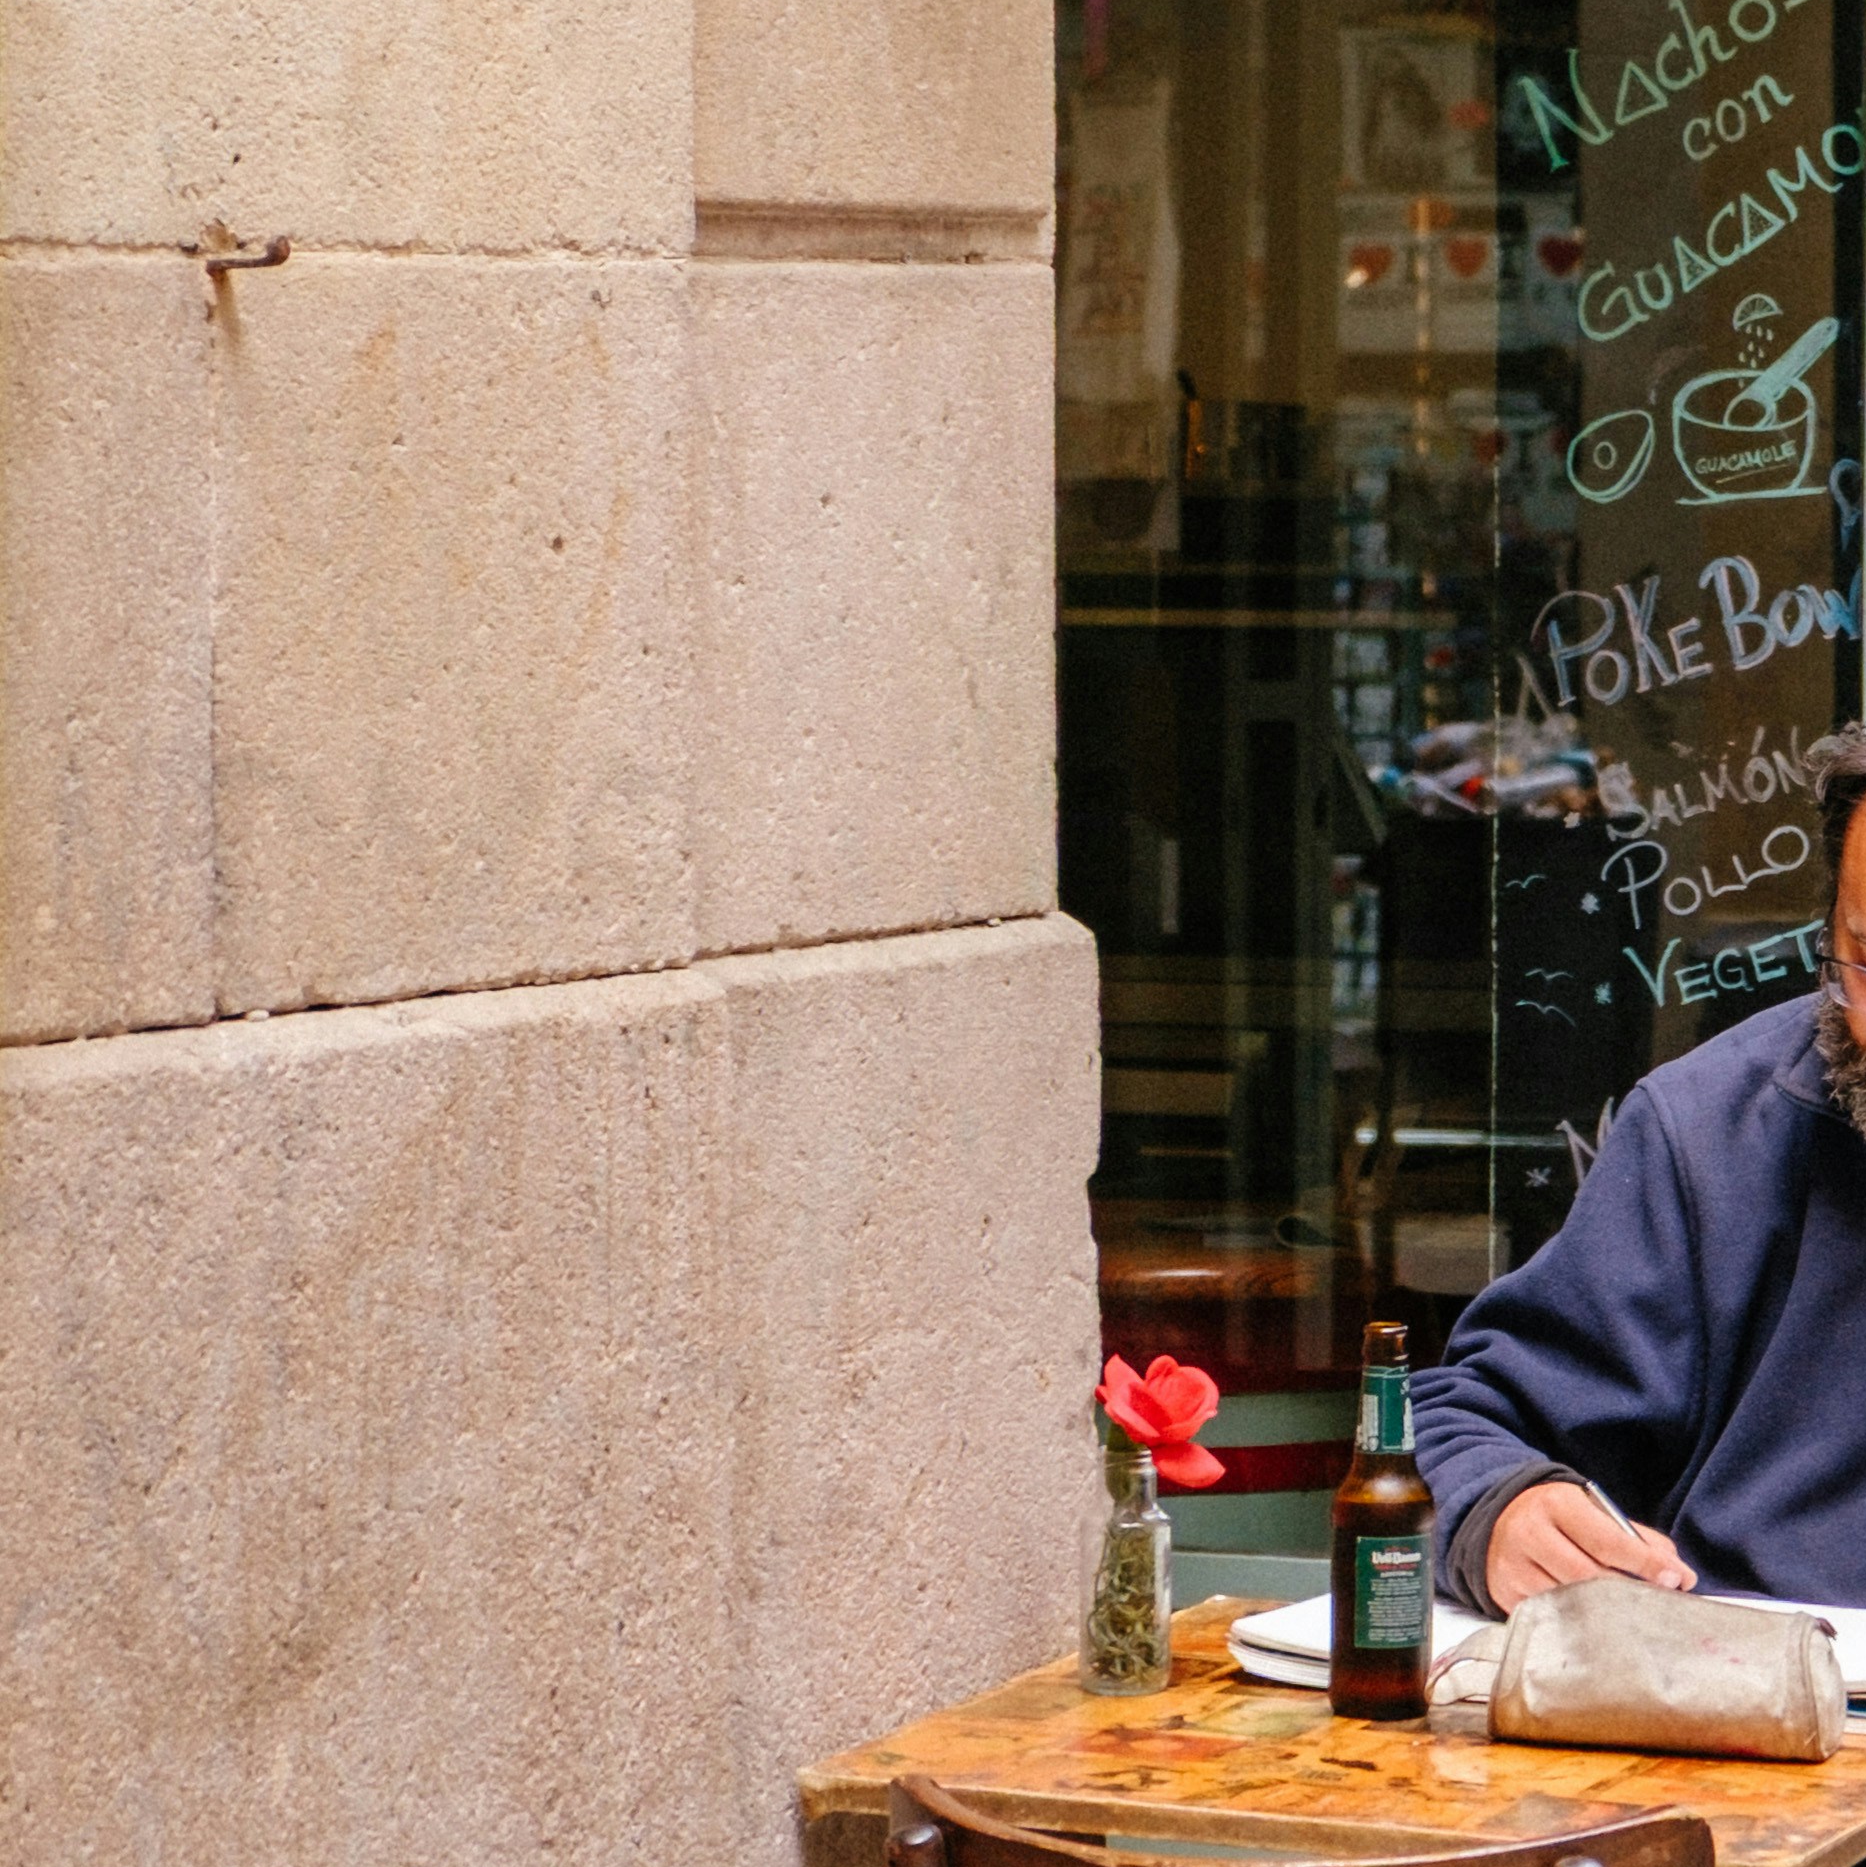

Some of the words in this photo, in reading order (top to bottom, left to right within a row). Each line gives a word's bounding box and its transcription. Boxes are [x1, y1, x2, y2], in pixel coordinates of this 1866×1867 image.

[1682, 74, 1796, 162] con
[1694, 438, 1798, 475] GUACAMOLE
[1600, 825, 1810, 930] POLLO
